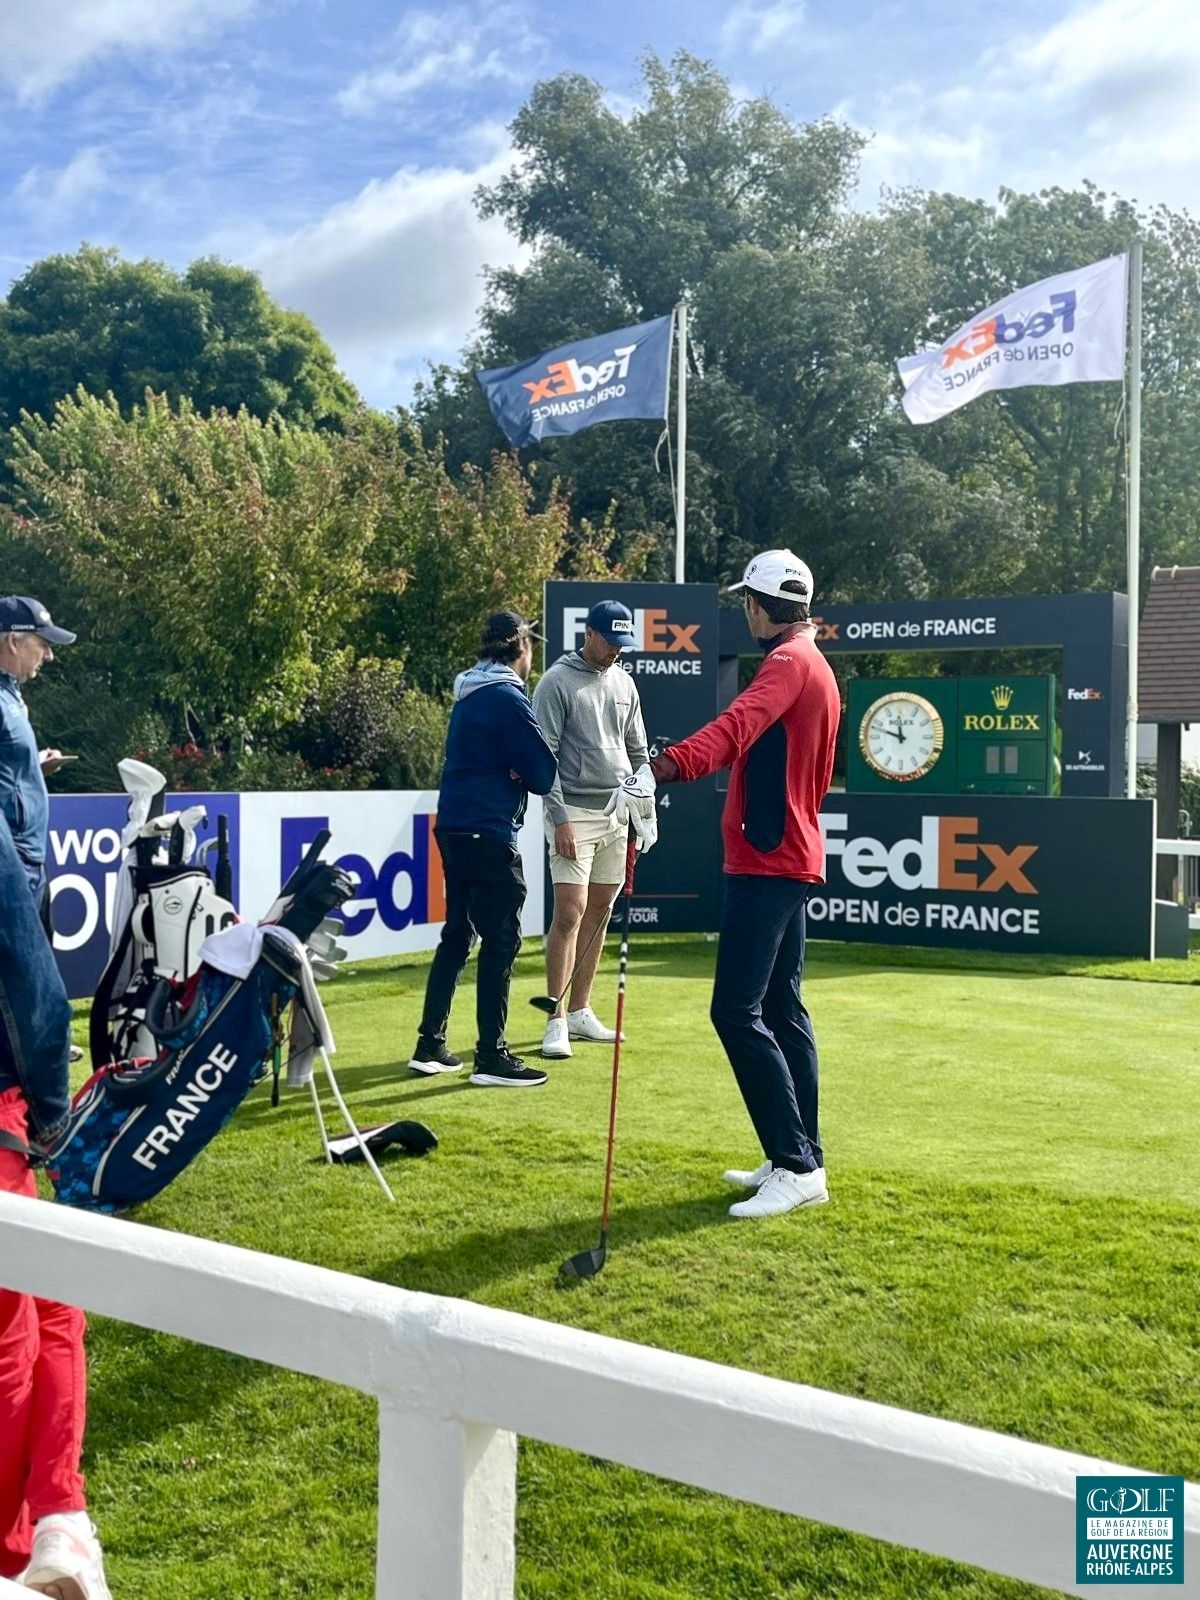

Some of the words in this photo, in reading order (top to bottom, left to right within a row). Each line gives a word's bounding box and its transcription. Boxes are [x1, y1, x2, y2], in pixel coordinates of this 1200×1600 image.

[614, 621, 631, 630] PIN
[846, 622, 895, 640] OPEN
[897, 620, 921, 638] de
[923, 617, 997, 637] FRANCE
[636, 659, 702, 675] FRANCE
[1067, 688, 1102, 700] FedEx
[963, 714, 1041, 731] ROLEX
[659, 793, 671, 808] 4
[817, 813, 1040, 895] FedEx
[807, 896, 879, 924] OPEN
[884, 901, 920, 927] de
[925, 903, 1040, 935] FRANCE
[131, 1042, 239, 1171] FRANCE
